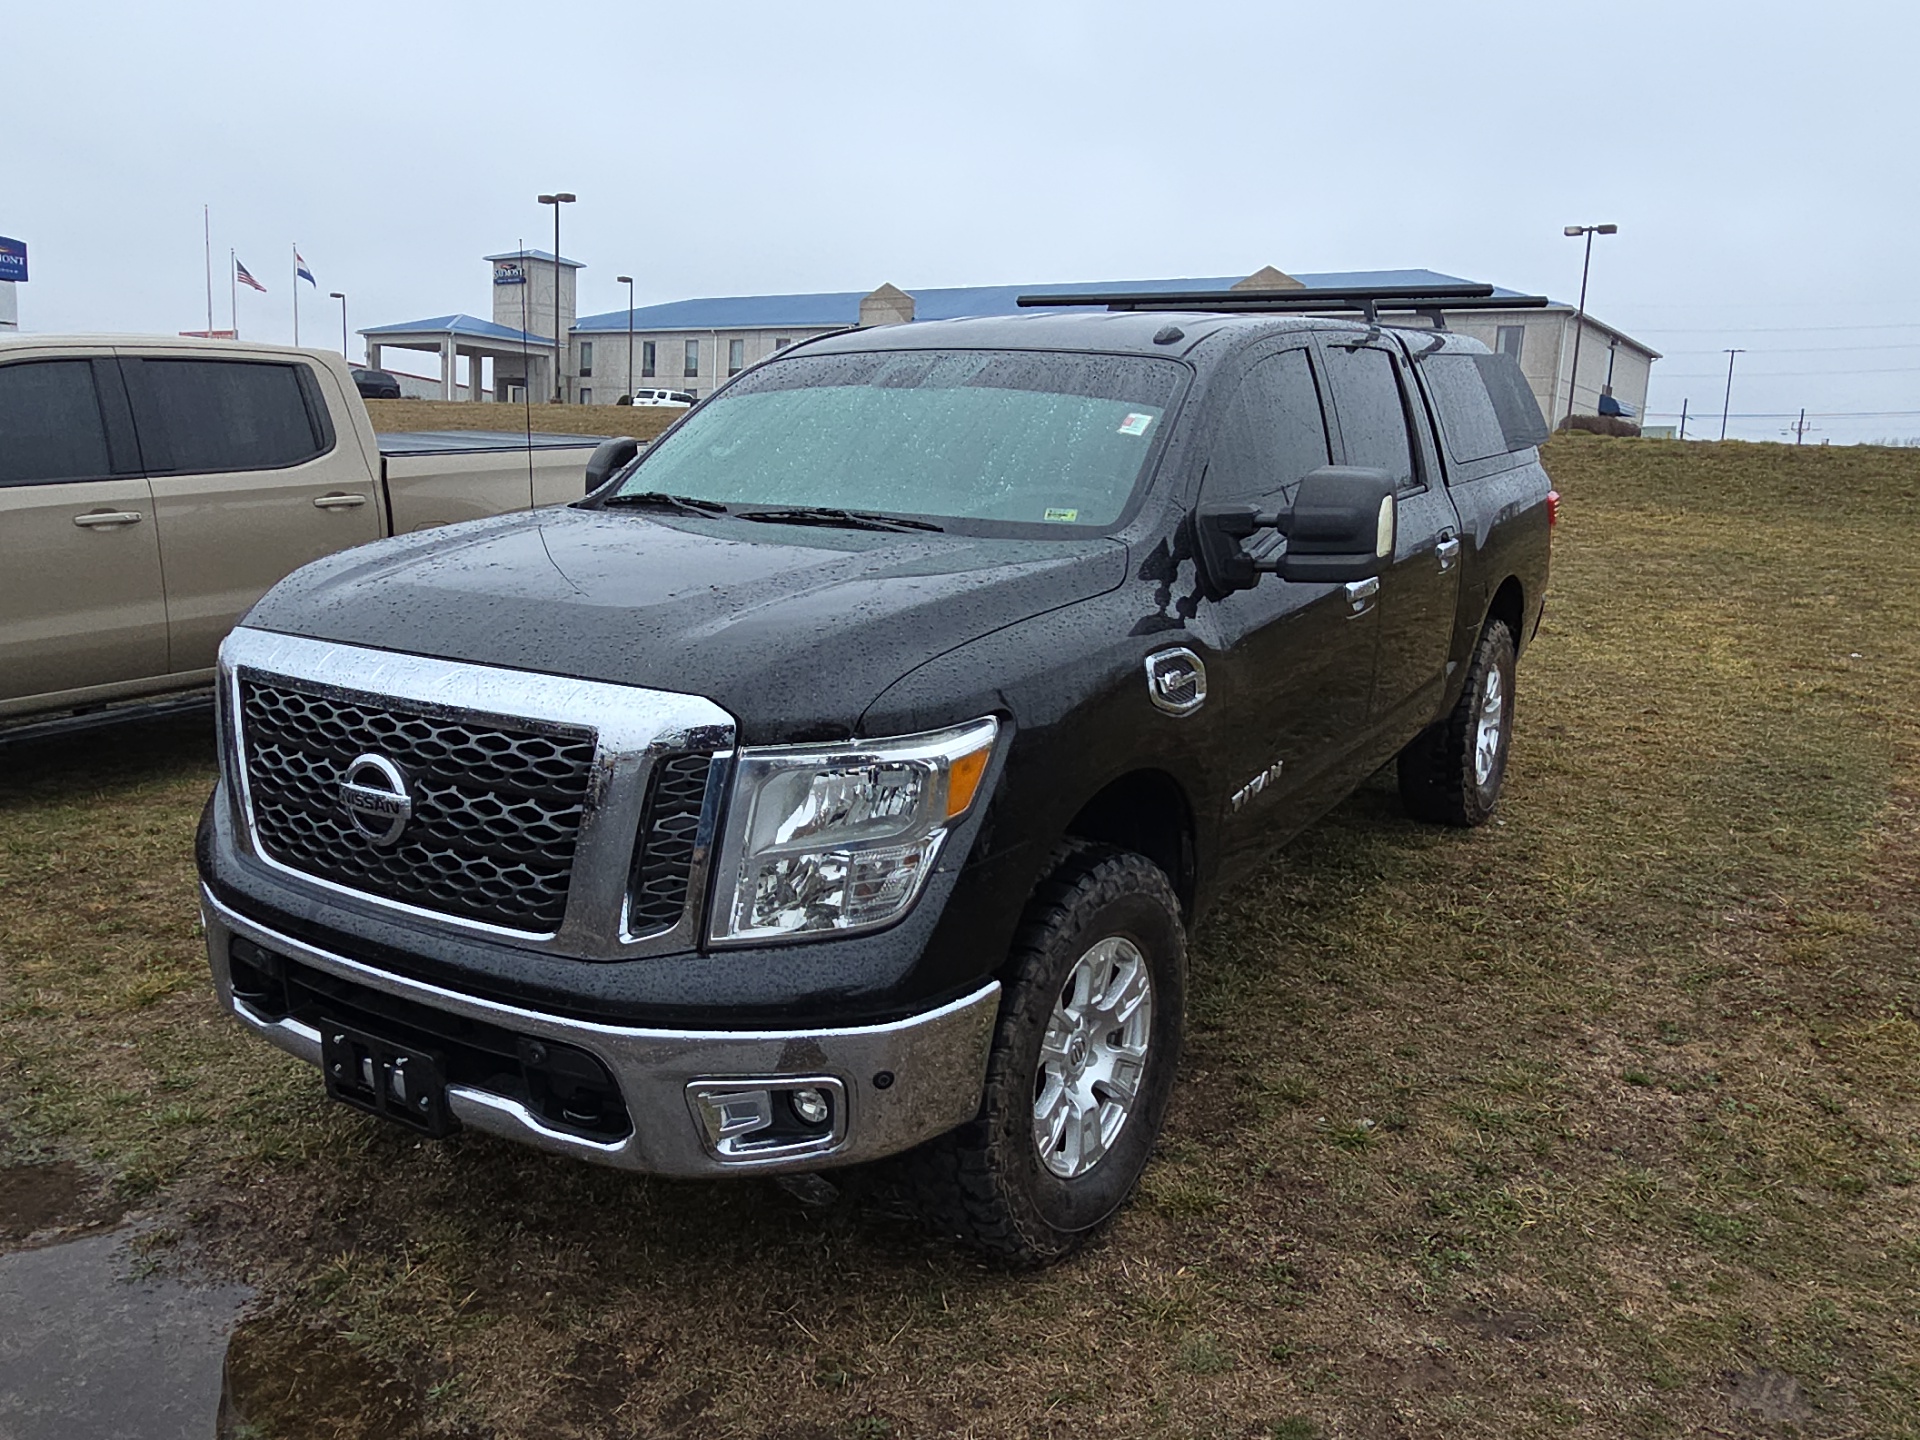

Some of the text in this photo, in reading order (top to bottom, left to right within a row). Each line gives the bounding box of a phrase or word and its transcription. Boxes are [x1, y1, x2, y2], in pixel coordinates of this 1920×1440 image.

[0, 254, 24, 265] ONT
[1231, 760, 1283, 812] TITAN
[340, 787, 400, 814] NISSAN
